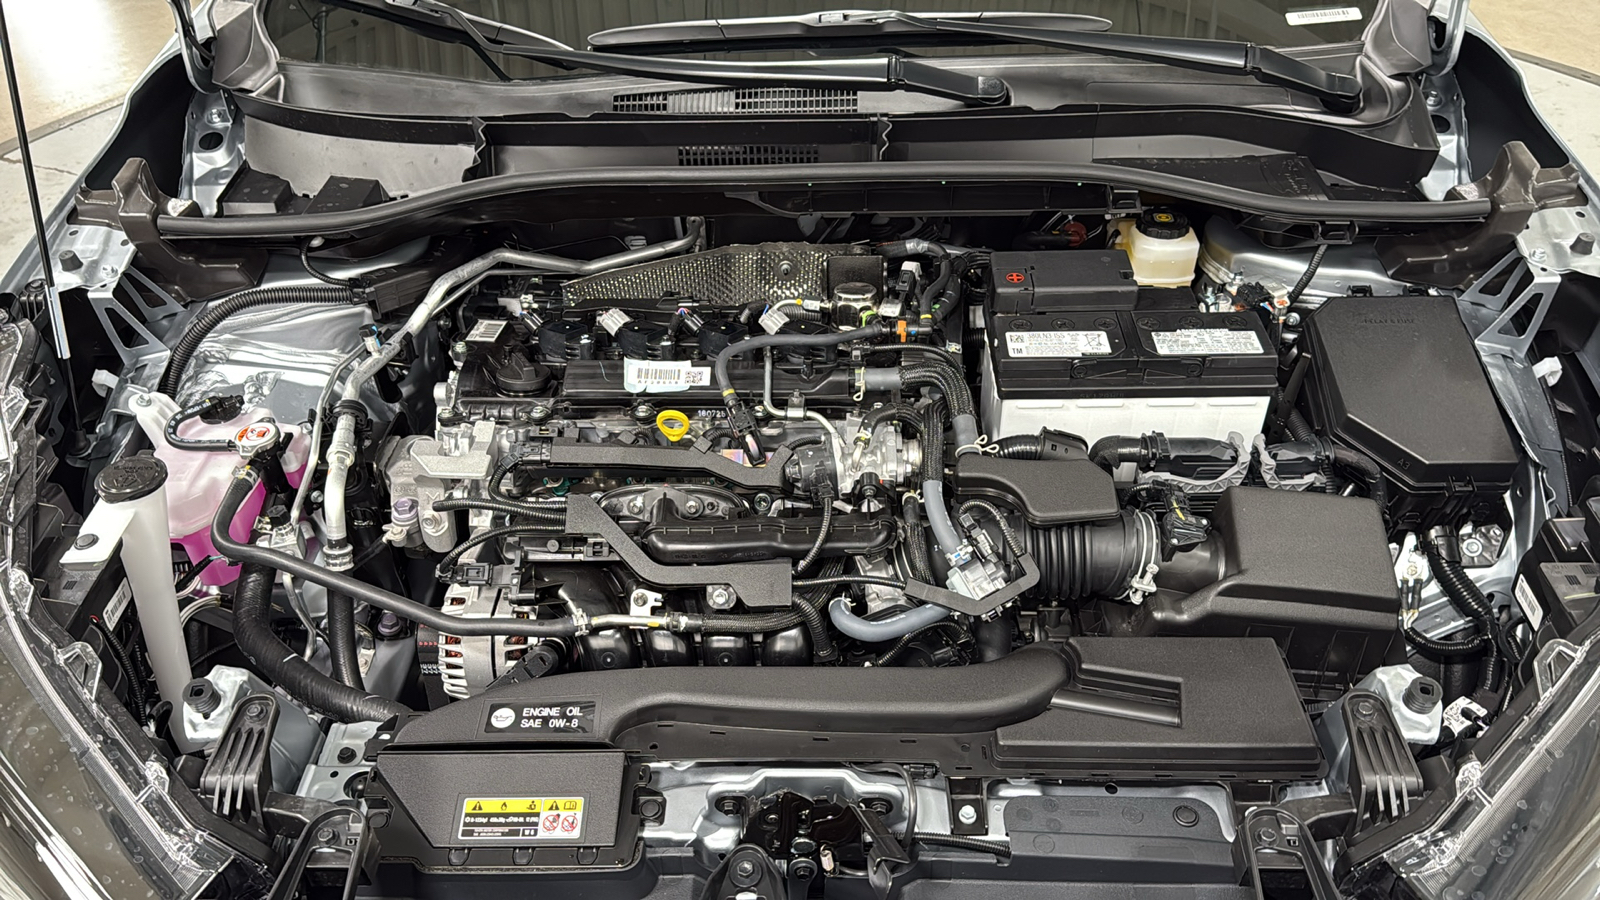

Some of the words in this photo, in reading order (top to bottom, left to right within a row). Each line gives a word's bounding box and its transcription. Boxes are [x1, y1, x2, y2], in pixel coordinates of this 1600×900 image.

[522, 707, 560, 716] ENGINE
[566, 706, 583, 716] OIL
[520, 719, 542, 728] SAE
[548, 718, 578, 728] 0W-8
